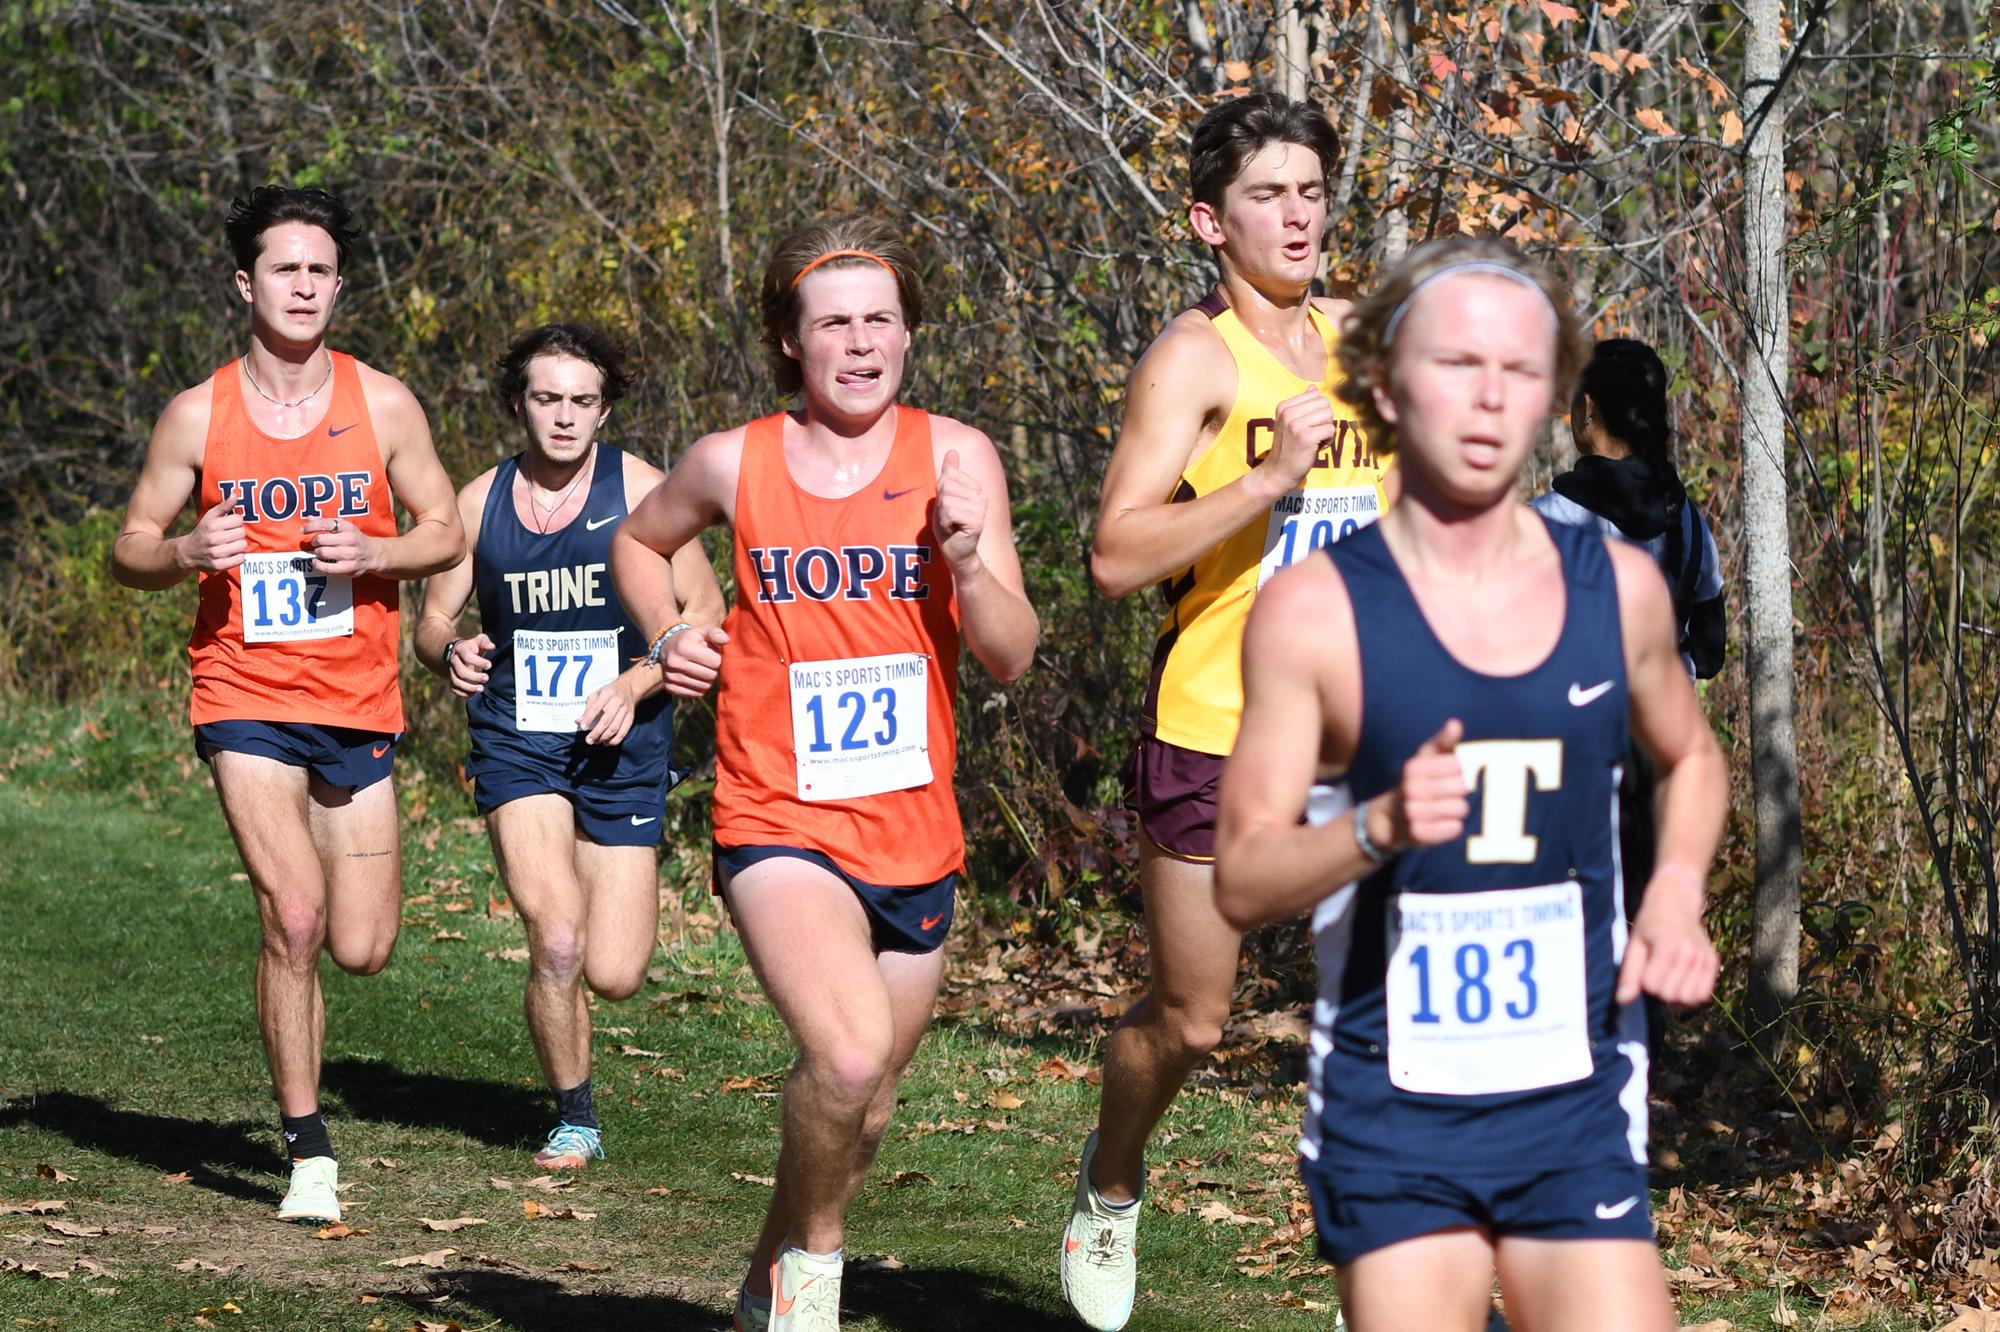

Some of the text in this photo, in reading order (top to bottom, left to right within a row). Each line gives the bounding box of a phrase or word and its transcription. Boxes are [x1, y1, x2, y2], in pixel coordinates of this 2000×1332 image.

[218, 471, 371, 522] HOPE
[1274, 494, 1378, 515] MAC'S SPORTS TIMING
[243, 561, 274, 575] MAC'S
[276, 559, 314, 574] SPORTS
[503, 563, 606, 614] TRINE
[749, 545, 932, 602] HOPE
[252, 576, 327, 627] 137
[516, 635, 615, 651] MAC'S SPORTS TIMING
[524, 654, 593, 697] 177
[794, 659, 924, 689] MAC'S SPORTS TIMING
[806, 687, 898, 753] 123
[1454, 738, 1564, 864] T
[1409, 938, 1538, 1024] 183
